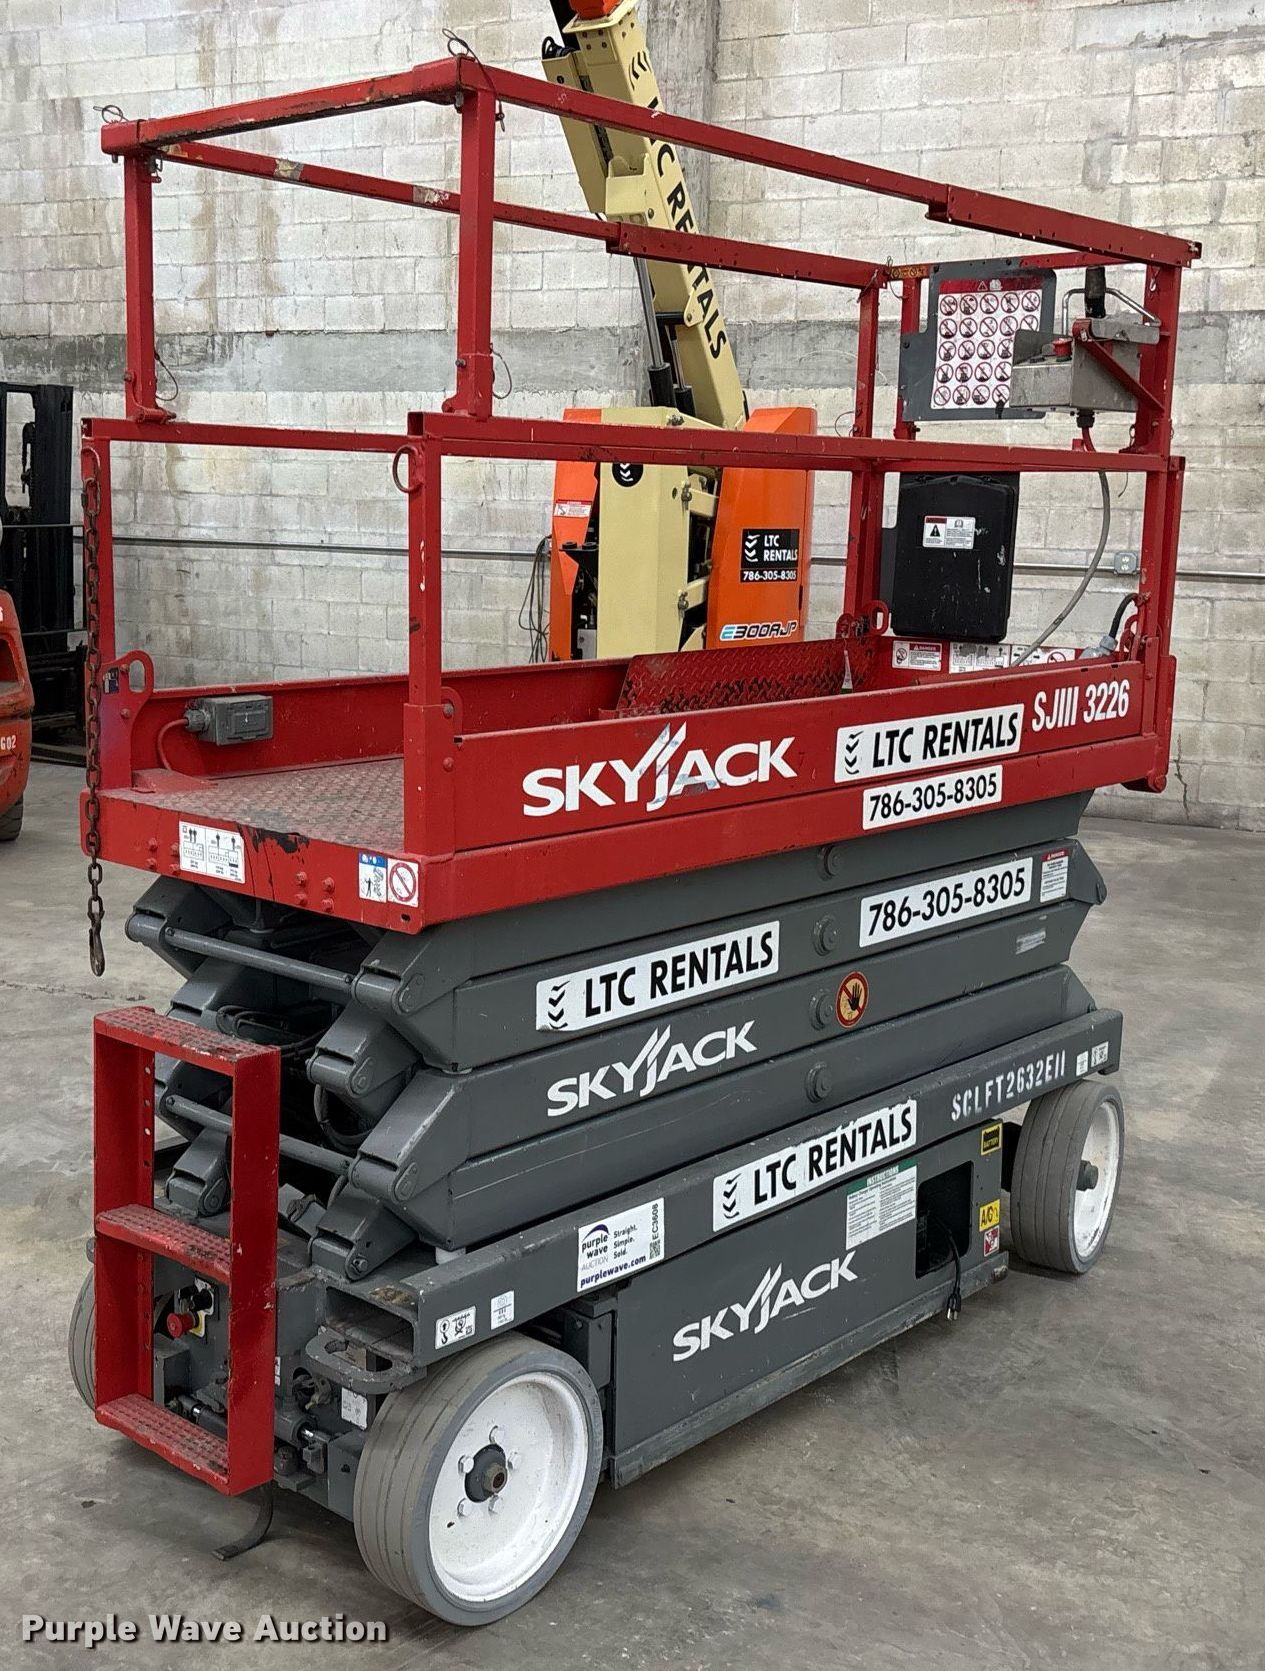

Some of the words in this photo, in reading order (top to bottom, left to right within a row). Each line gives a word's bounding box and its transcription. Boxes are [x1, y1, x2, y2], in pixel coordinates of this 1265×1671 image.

[668, 181, 727, 359] RETALS
[763, 549, 798, 562] RENTALS
[764, 535, 780, 547] LTC
[743, 570, 797, 581] 786-305-8305
[1031, 686, 1079, 732] SJIII
[1083, 679, 1130, 723] 3226
[872, 727, 914, 769] LTC
[922, 712, 1019, 760] RENTALS
[522, 721, 798, 817] SKYJACK
[869, 772, 998, 822] 786-305-8305
[868, 867, 1025, 937] 786-305-8305
[585, 966, 636, 1018] LTC
[650, 930, 773, 1000] RENTALS
[547, 1020, 758, 1117] SKYJACK
[753, 1152, 797, 1206] LTC
[808, 1106, 912, 1181] RENTALS
[581, 1233, 608, 1253] purple
[587, 1245, 608, 1259] wave
[613, 1224, 637, 1239] Straight.
[613, 1237, 635, 1249] Simple.
[580, 1255, 647, 1289] purplewave.com
[581, 1256, 608, 1271] AUCTION
[613, 1248, 627, 1259] Sold.
[672, 1250, 859, 1362] SKYJACK
